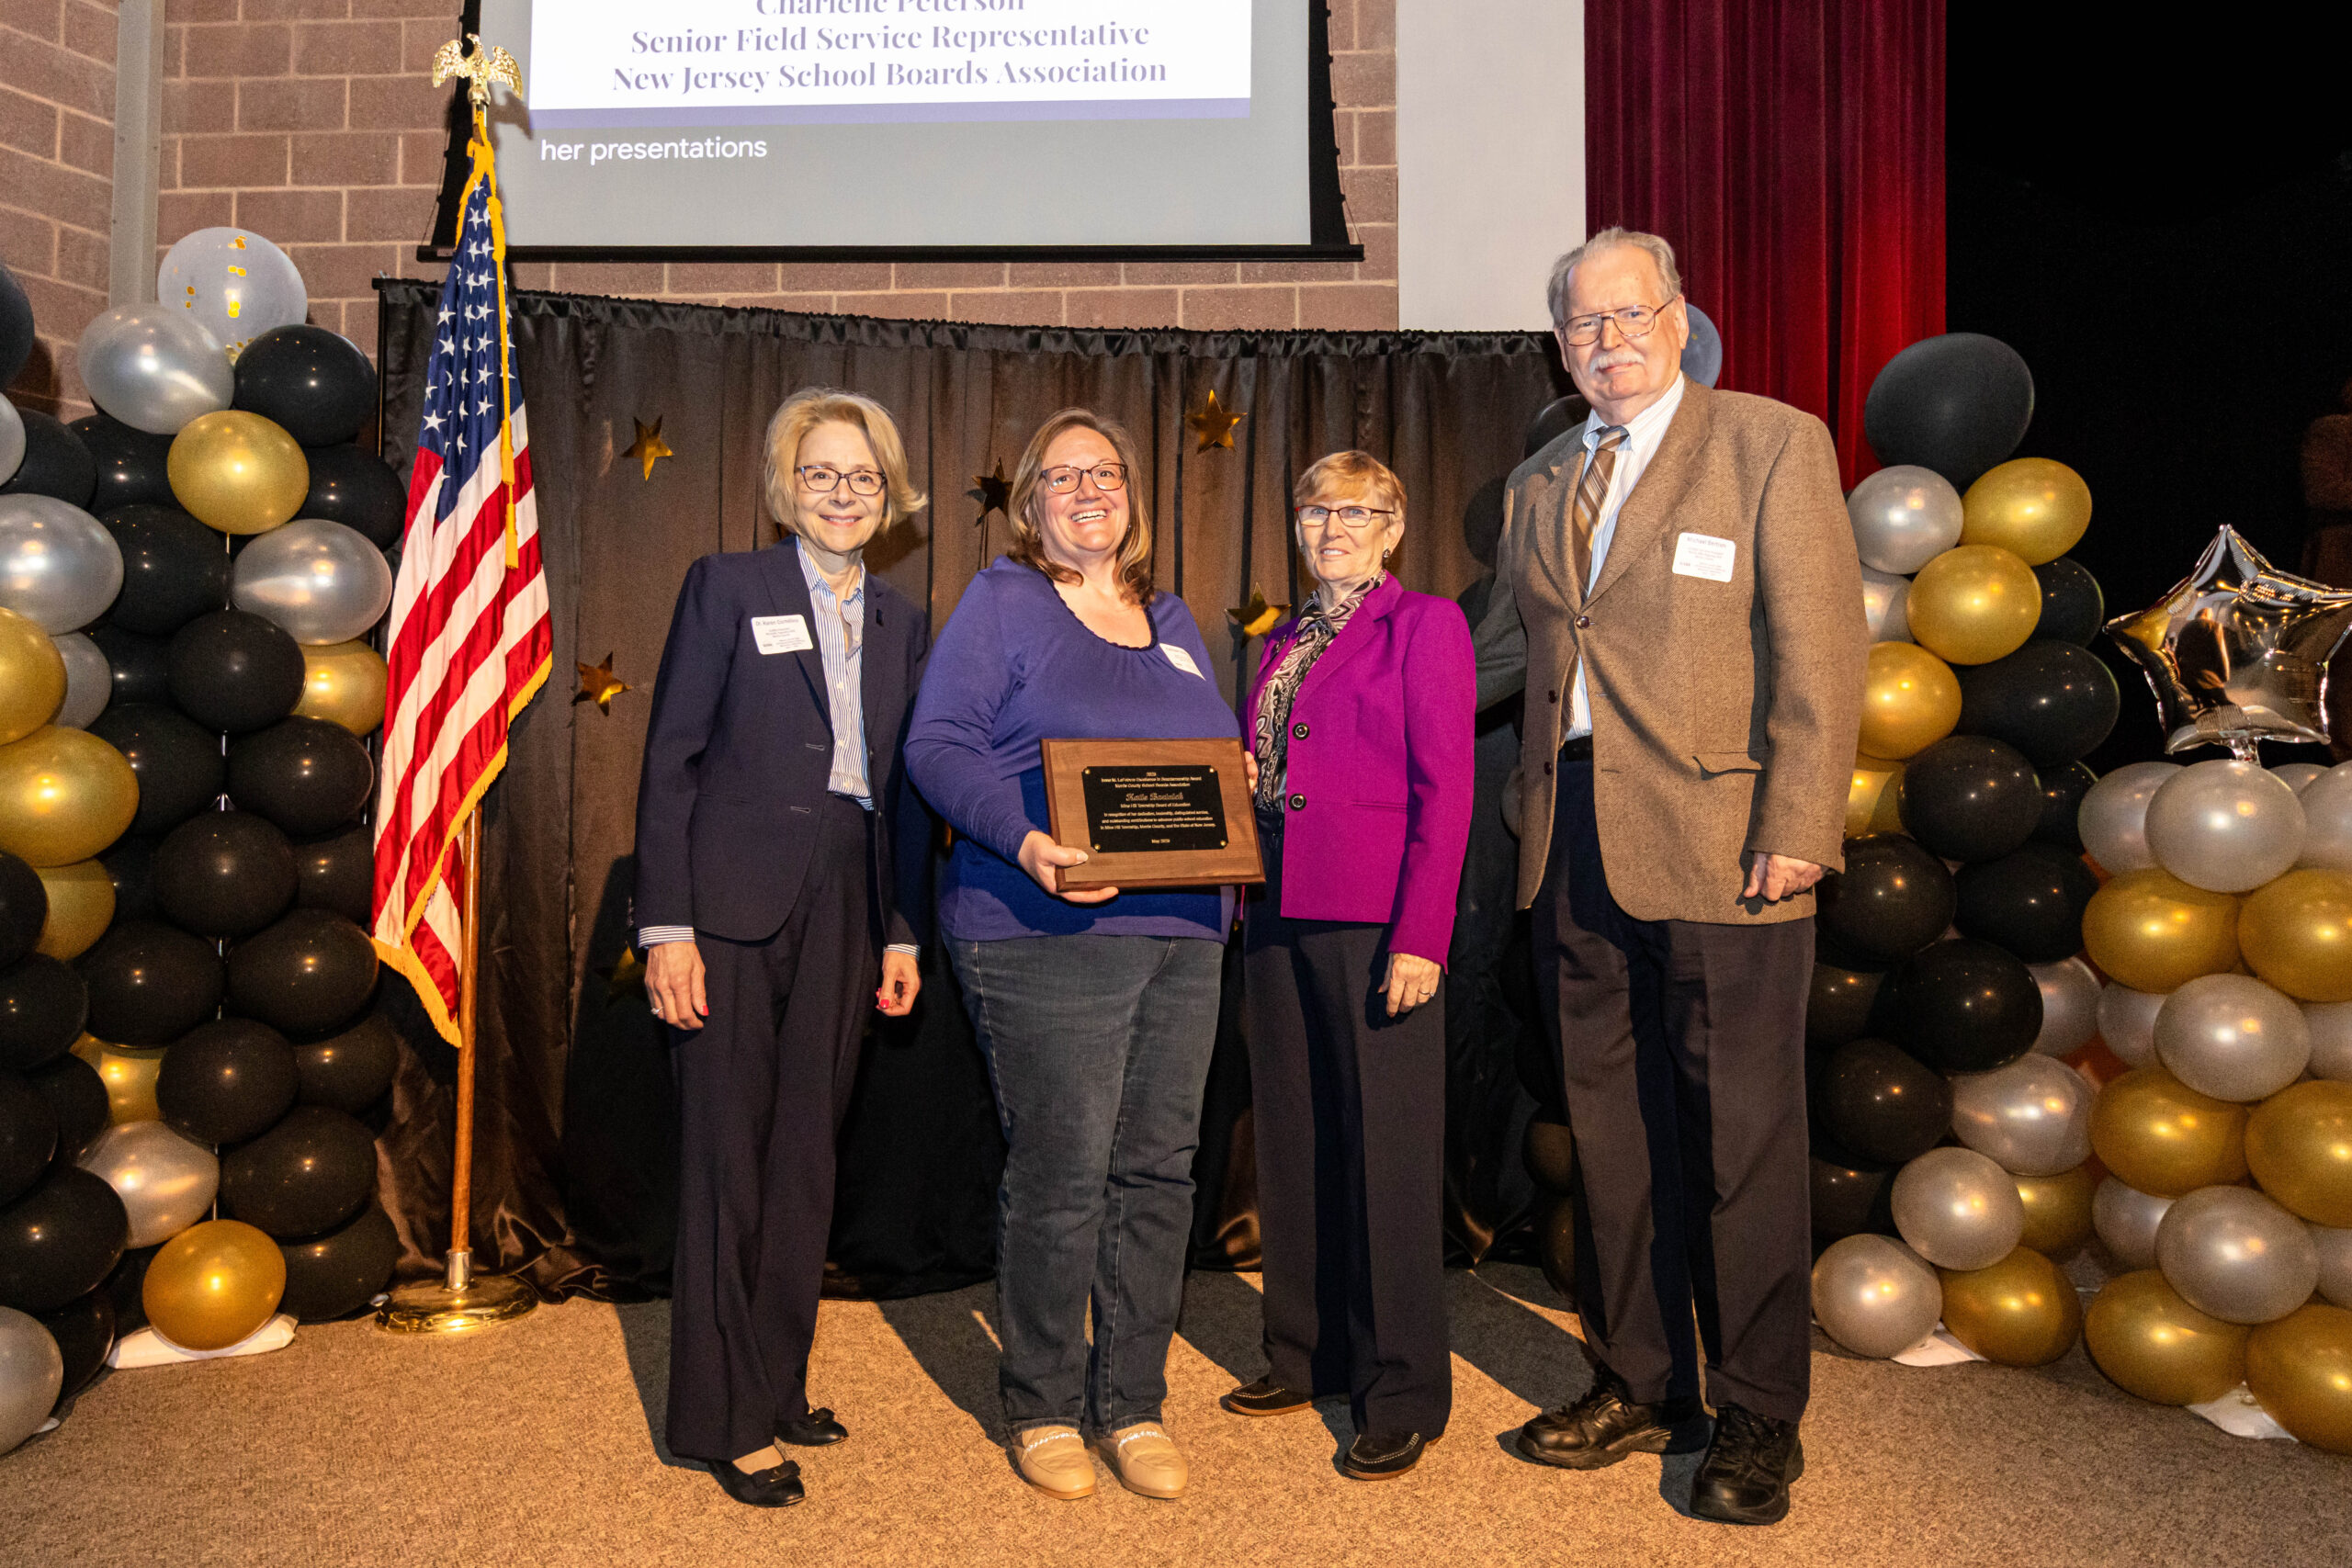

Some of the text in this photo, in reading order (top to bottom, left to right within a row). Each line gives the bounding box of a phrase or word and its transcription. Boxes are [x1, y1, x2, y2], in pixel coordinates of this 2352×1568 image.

[631, 21, 1149, 54] Senior Field Service Representative
[612, 57, 1167, 95] New Jersey School Boards Association
[540, 136, 768, 166] her presentations
